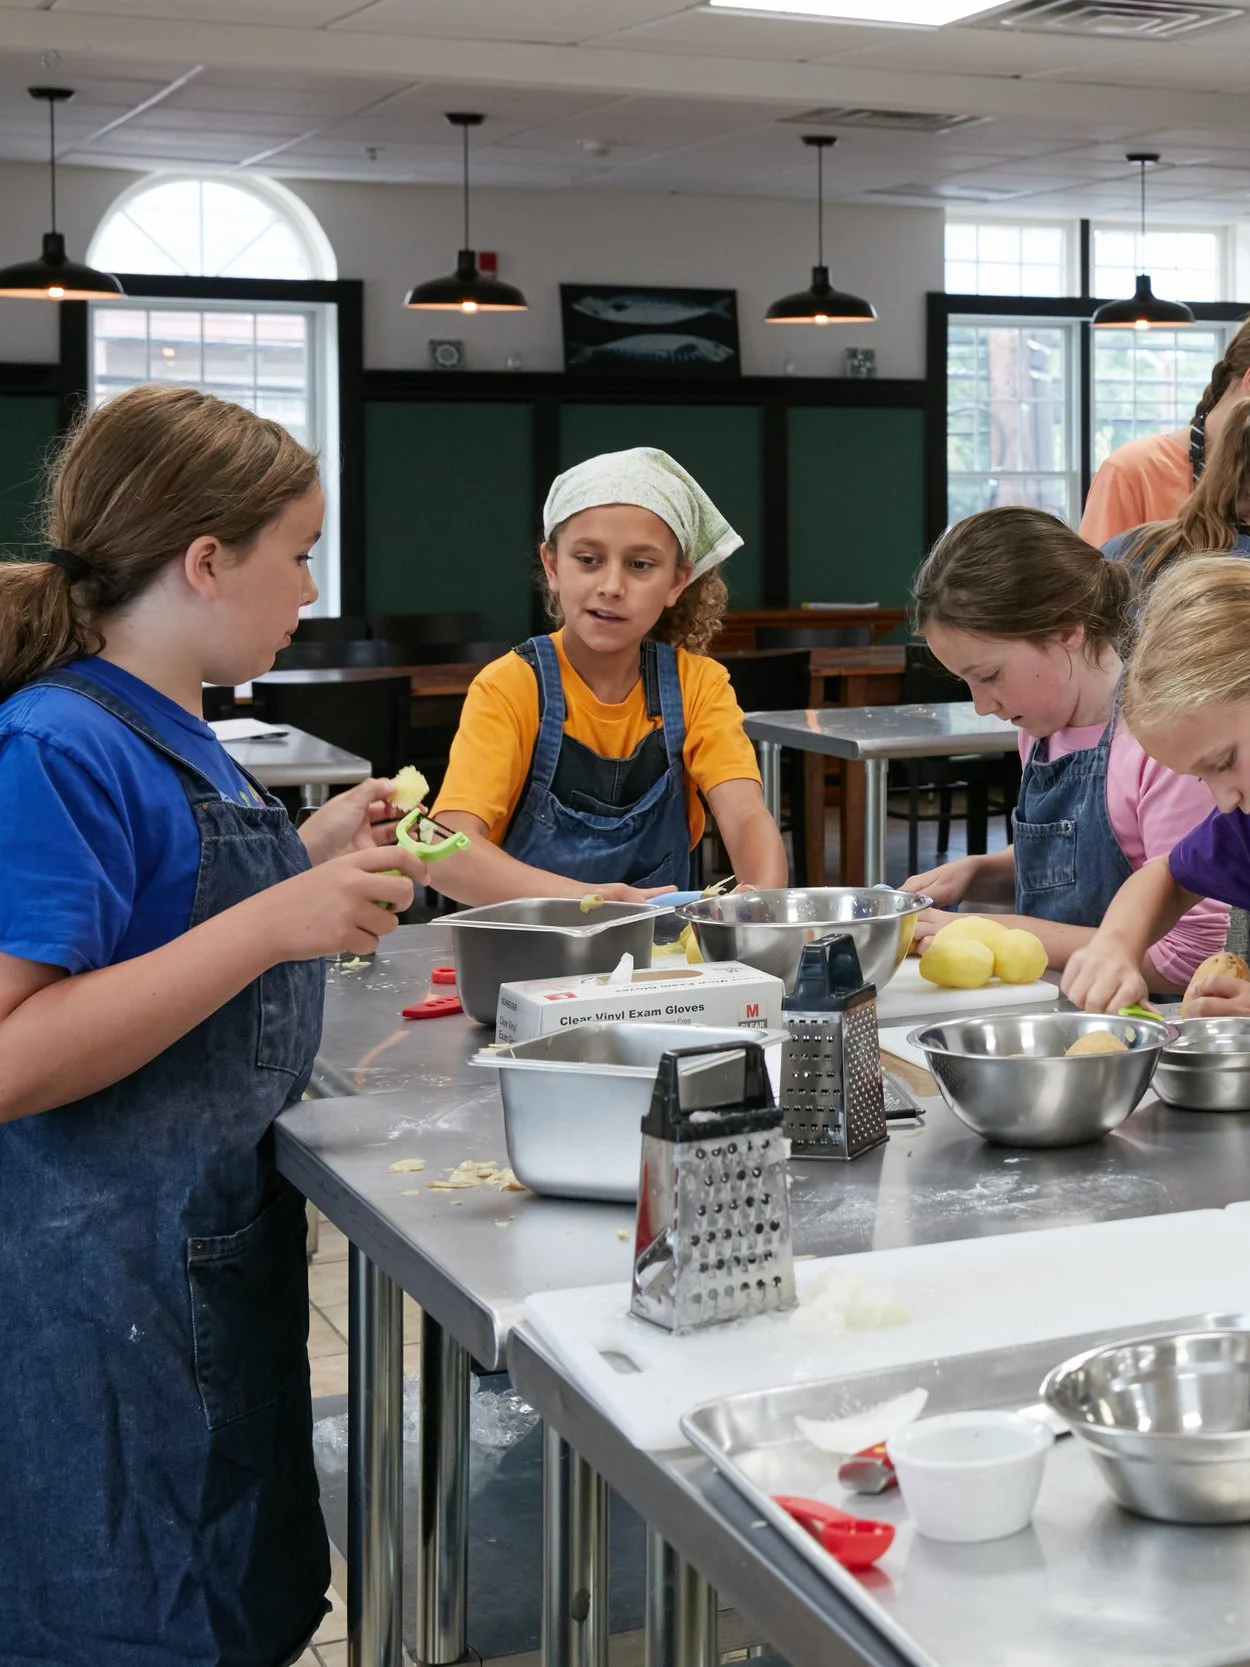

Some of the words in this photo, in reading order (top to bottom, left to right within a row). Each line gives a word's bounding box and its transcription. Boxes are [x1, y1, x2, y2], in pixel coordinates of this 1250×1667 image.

[559, 1015, 592, 1026] Clear
[595, 1009, 625, 1021] Vinyl
[629, 1008, 662, 1019] Exam
[665, 1003, 705, 1015] Gloves
[746, 1003, 759, 1018] M
